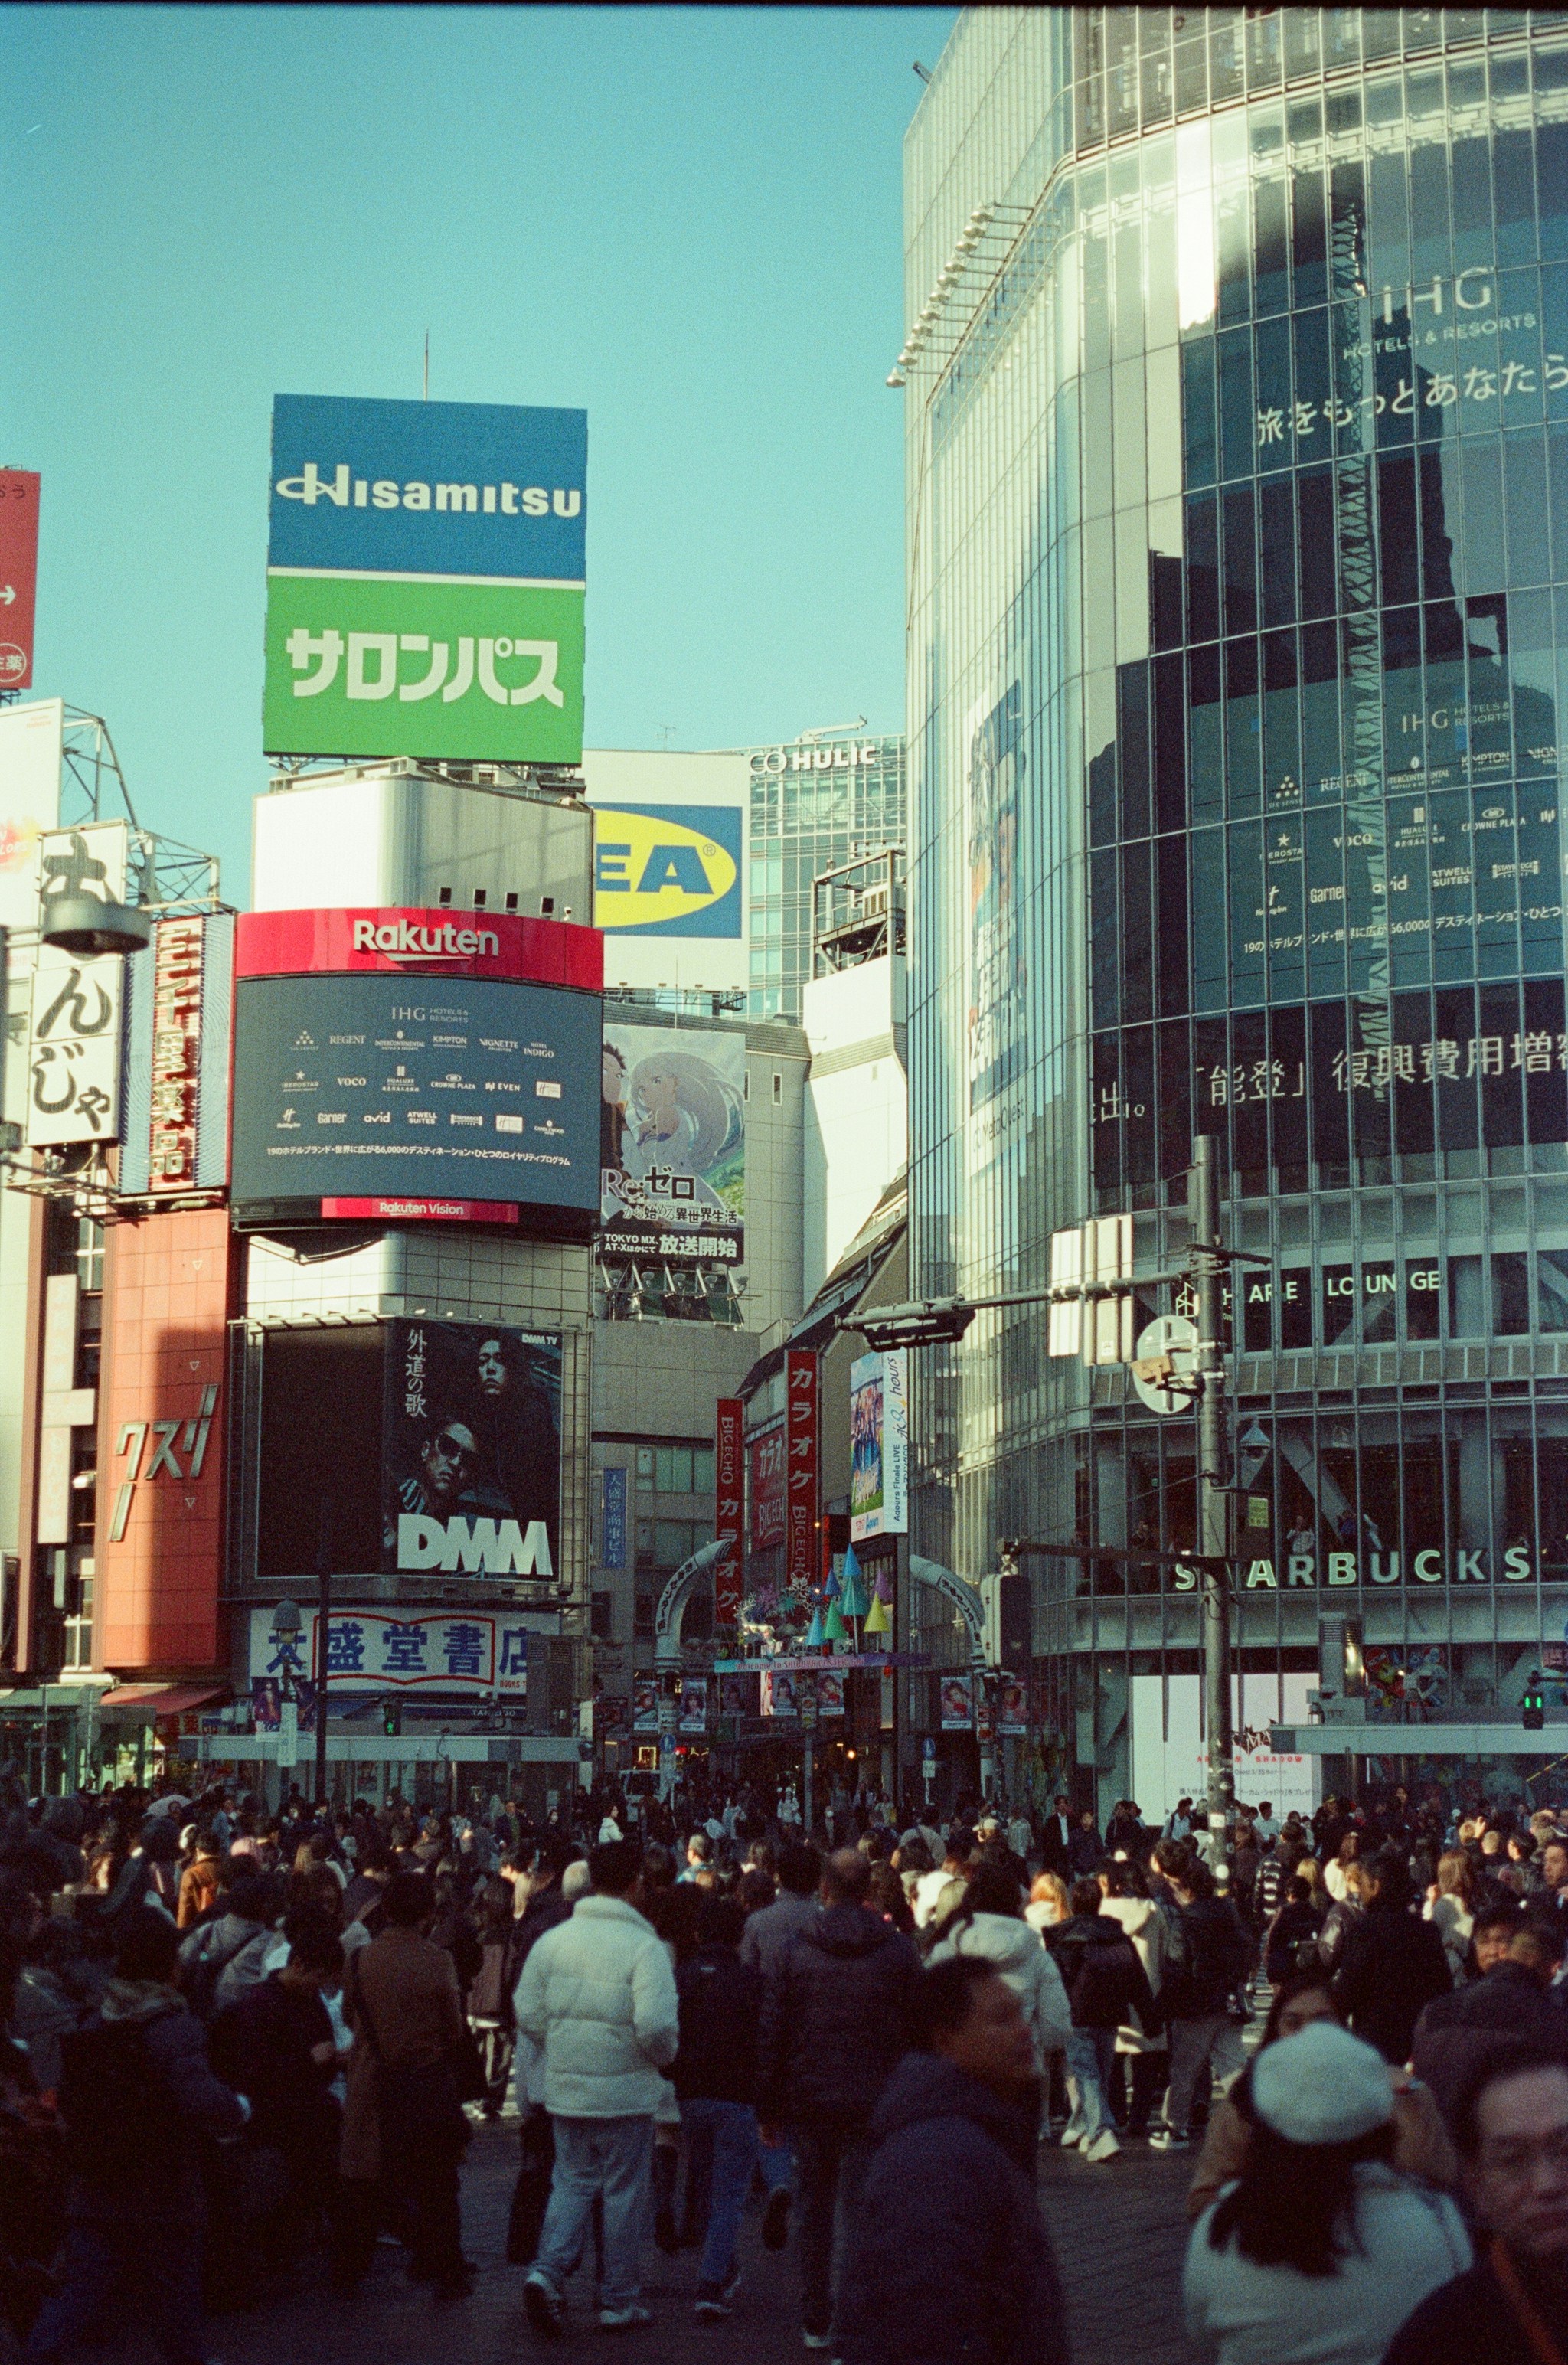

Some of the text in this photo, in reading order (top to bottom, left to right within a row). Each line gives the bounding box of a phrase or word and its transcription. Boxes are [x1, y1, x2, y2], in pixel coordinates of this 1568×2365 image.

[1383, 266, 1491, 325] IHG
[1425, 330, 1437, 346] &
[1443, 313, 1536, 341] RESORTS
[276, 462, 581, 518] Hisamitsu
[286, 629, 564, 708] サロンパス
[1402, 710, 1449, 733] IHG
[792, 746, 877, 771] HULIC
[1433, 877, 1470, 887] SUITES
[354, 920, 499, 957] Rakuten
[392, 1007, 426, 1021] IHG
[330, 1035, 366, 1045] REGENT
[433, 1035, 468, 1044] KIMPTON
[524, 1047, 555, 1058] INDIGO
[498, 1083, 521, 1092] EVEN
[318, 1112, 347, 1124] Garner
[364, 1112, 391, 1123] avid
[380, 1202, 464, 1216] Rakuten Vision
[604, 1233, 639, 1243] TOKYO
[659, 1234, 737, 1258] 放送開始
[1223, 1281, 1298, 1307] HARE
[545, 1336, 557, 1346] TV
[405, 1328, 428, 1418] 外道の歌
[790, 1367, 813, 1490] カラオケ
[720, 1416, 734, 1485] BIG ECHO
[792, 1506, 806, 1536] BIG
[397, 1513, 554, 1576] DMM
[1176, 1547, 1532, 1591] SARBUCKS
[266, 1621, 541, 1675] 大盛堂書店
